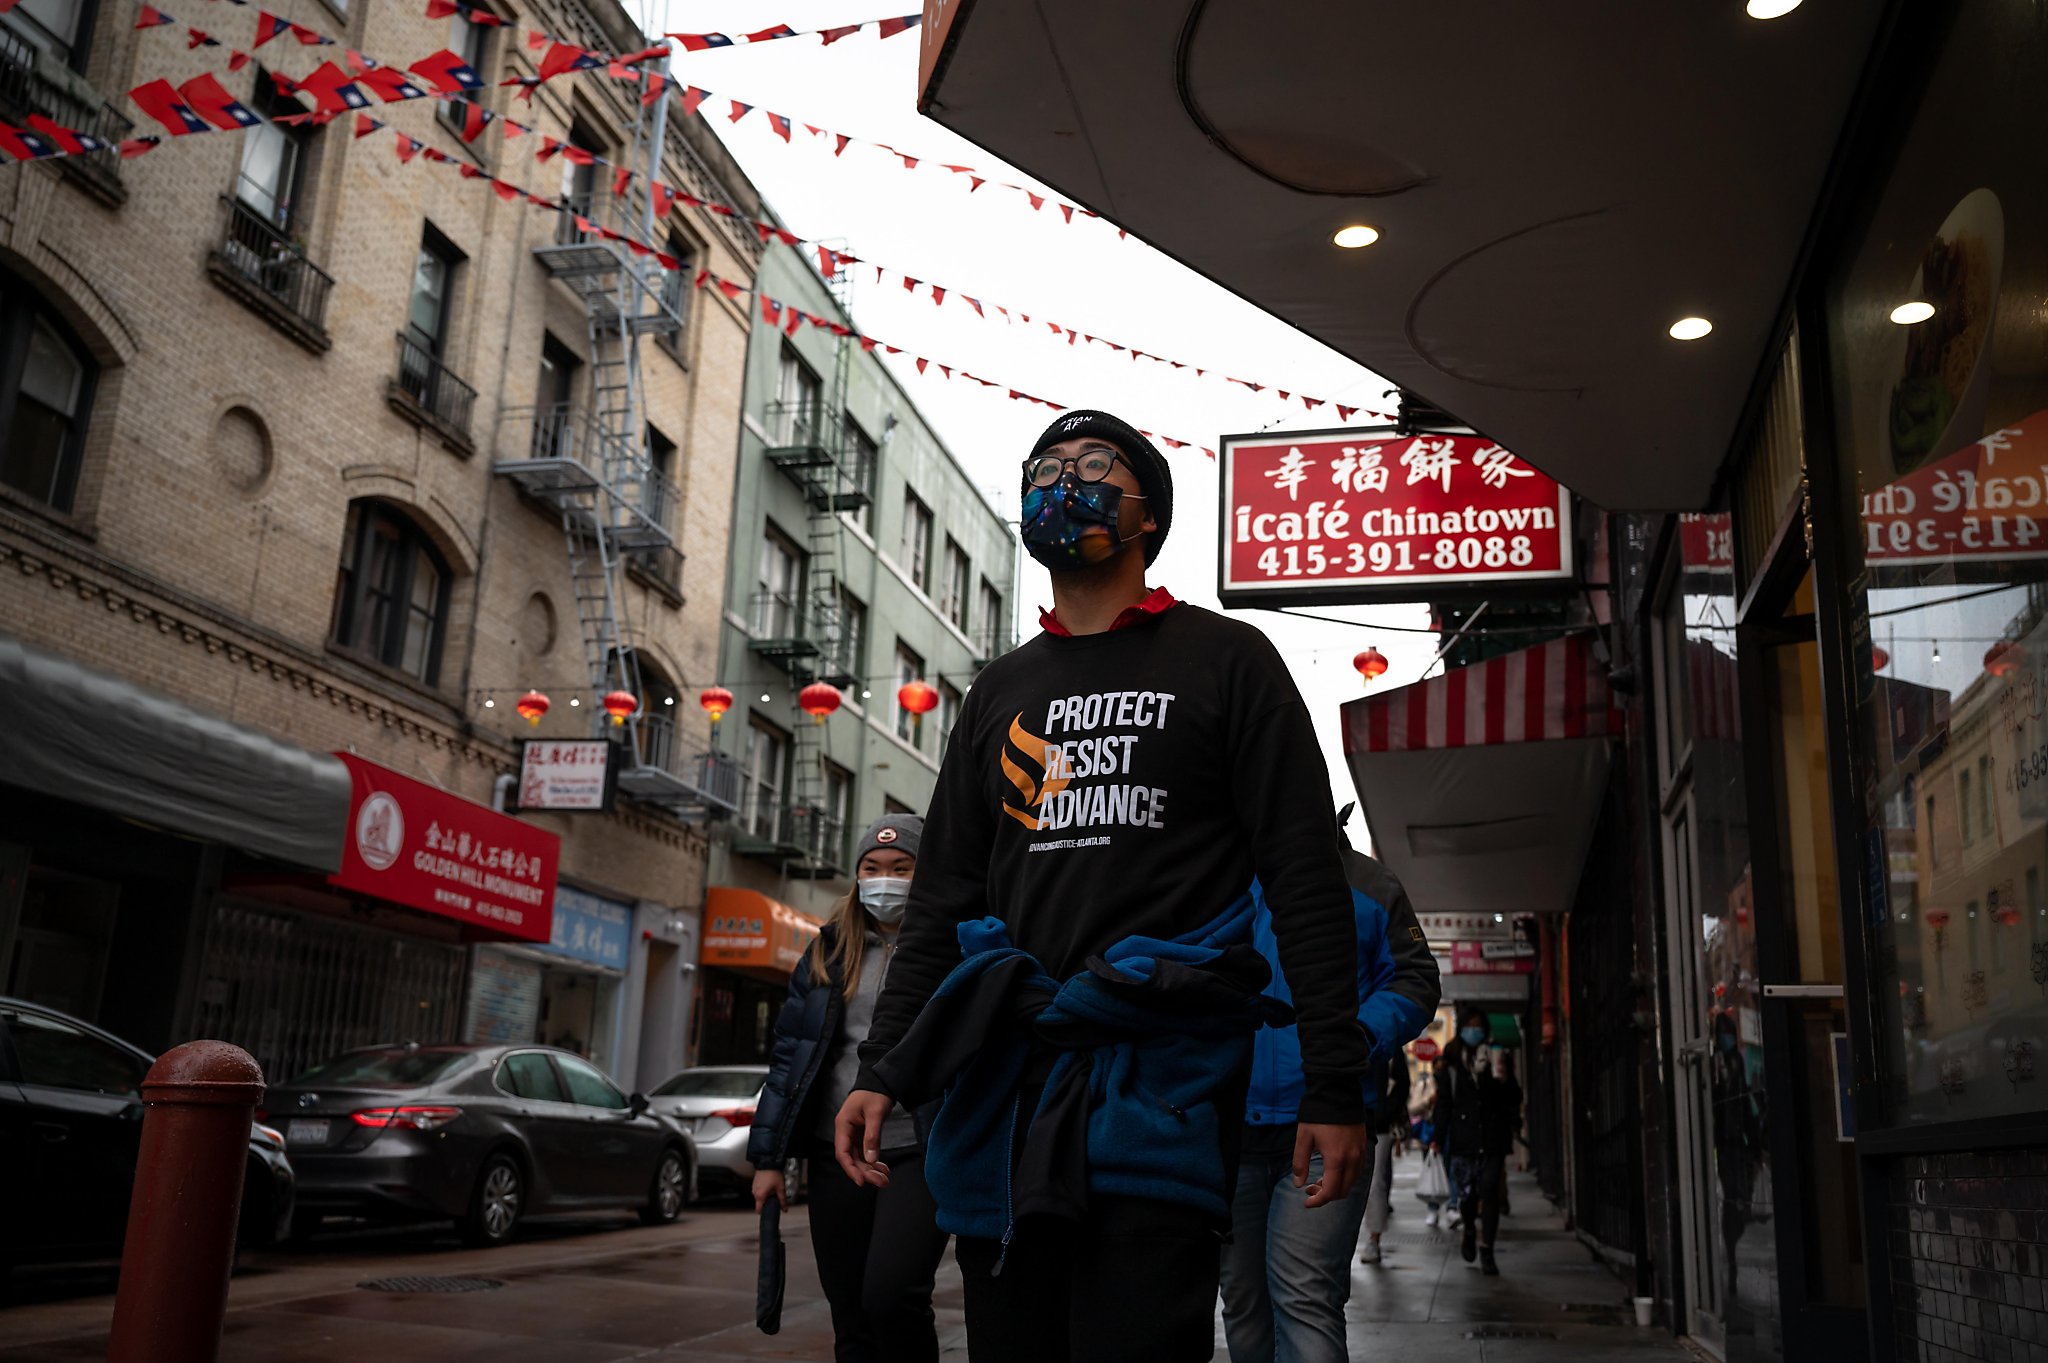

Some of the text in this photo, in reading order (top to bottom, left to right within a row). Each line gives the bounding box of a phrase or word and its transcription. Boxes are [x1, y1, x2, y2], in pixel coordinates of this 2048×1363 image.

[1264, 437, 1536, 502] 幸福餅家
[1235, 501, 1556, 545] icafé Chinatown
[1257, 535, 1534, 577] 415-391-8088
[1044, 690, 1176, 736] PROTECT
[1042, 735, 1139, 783] RESIST
[1036, 784, 1168, 832] ADVANCE
[413, 850, 460, 881] GOLDEN
[459, 863, 484, 890] HILL
[484, 872, 545, 907] MONUMENT
